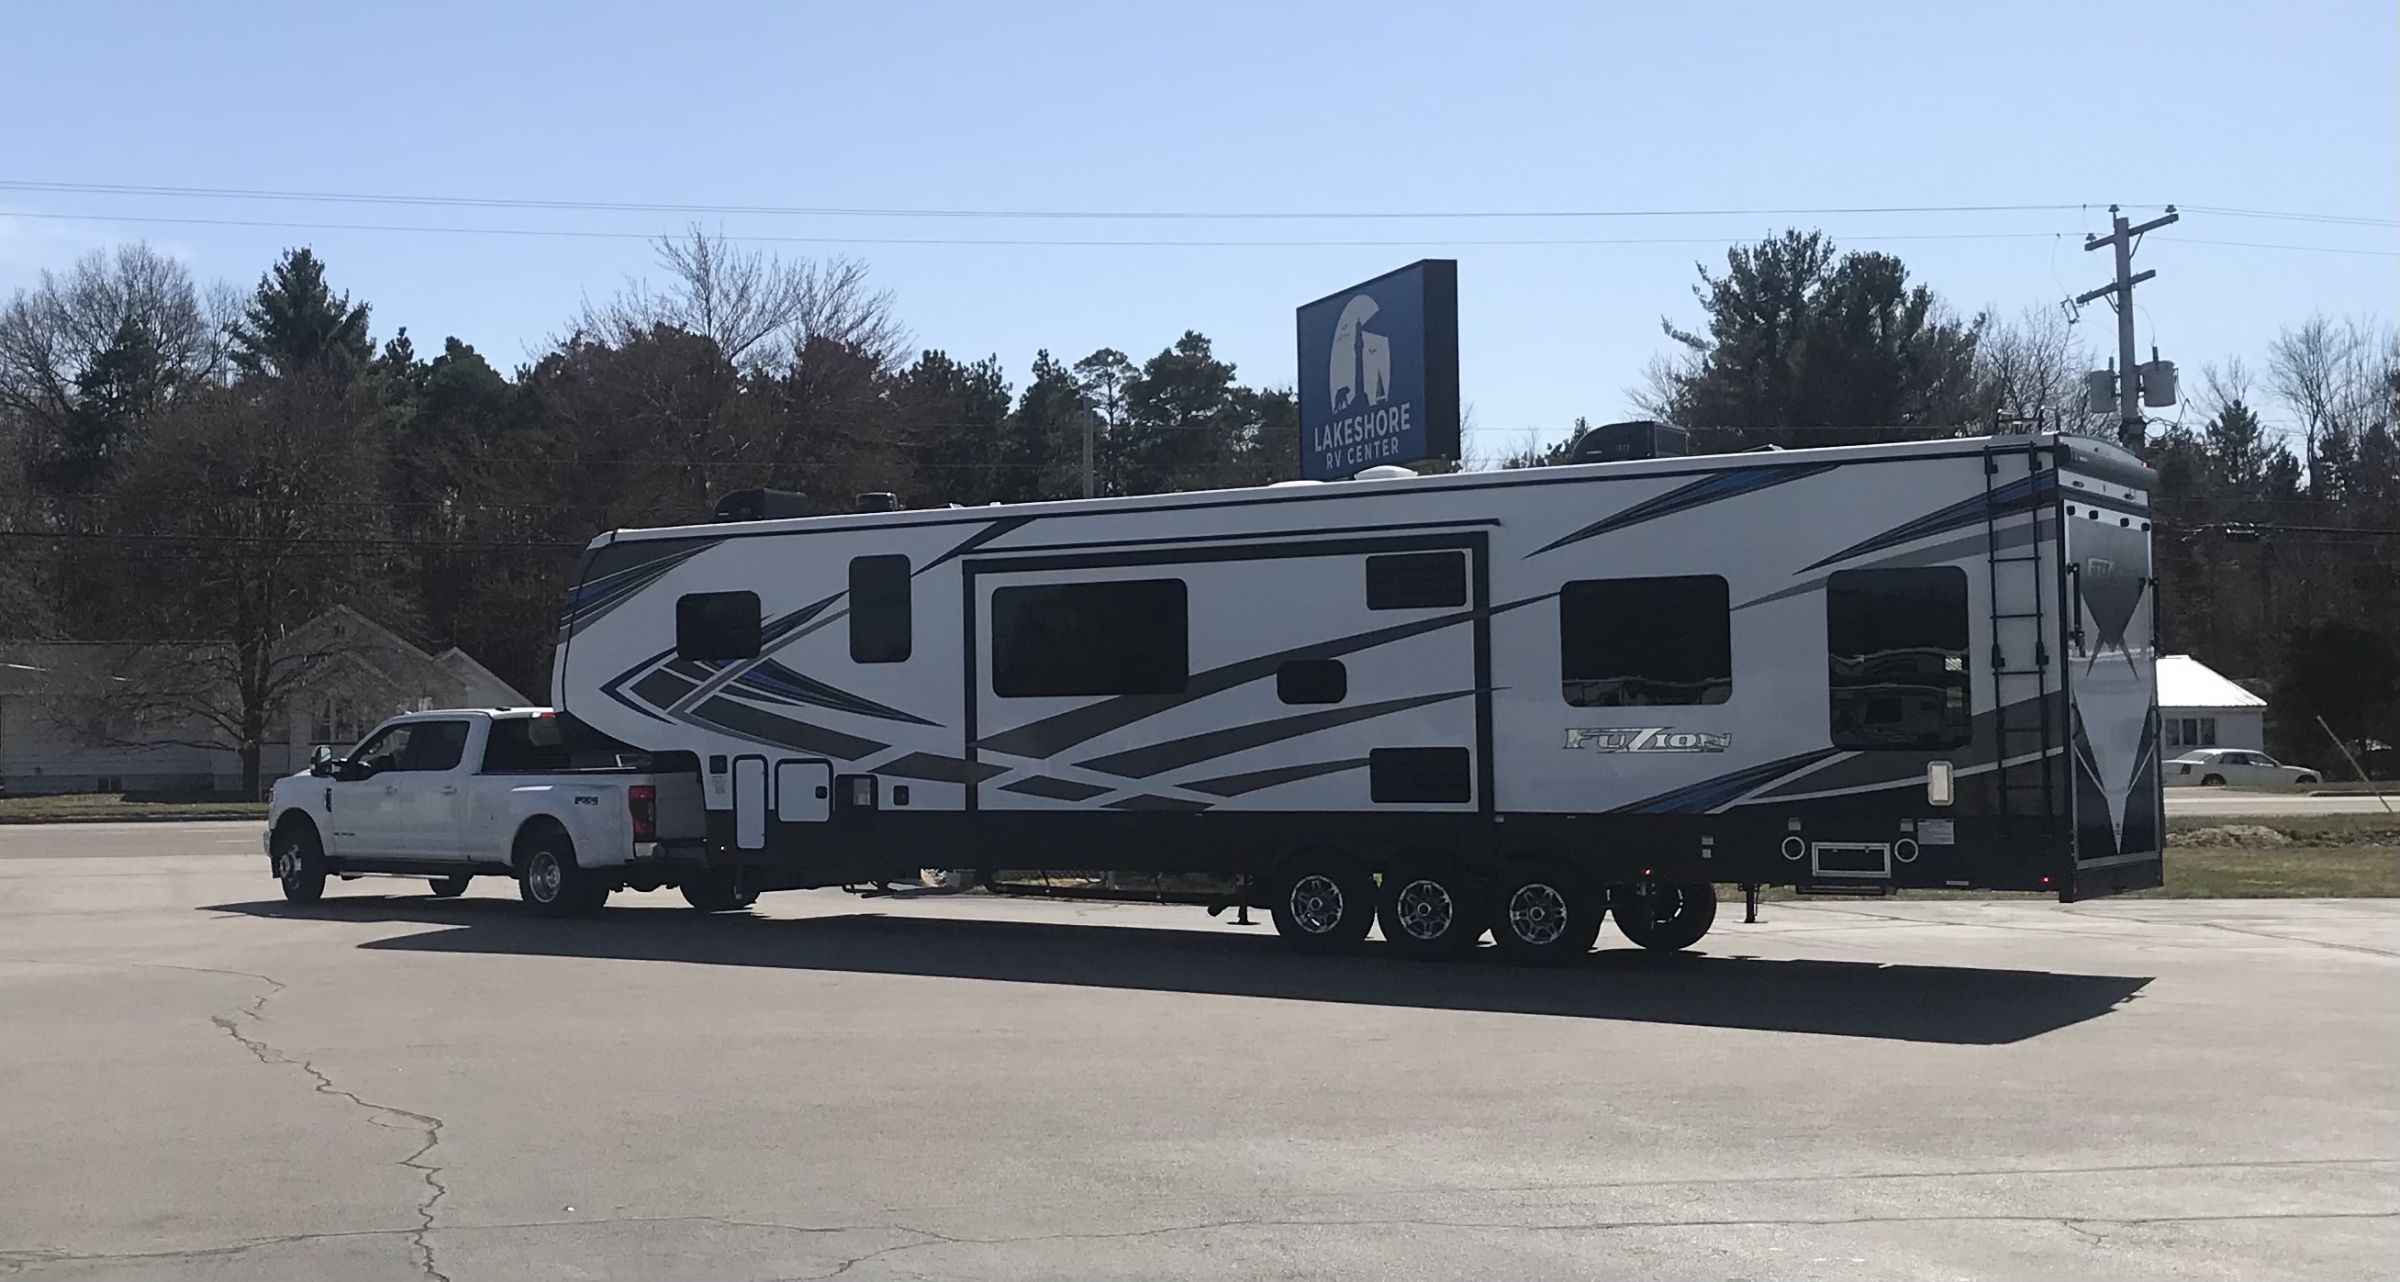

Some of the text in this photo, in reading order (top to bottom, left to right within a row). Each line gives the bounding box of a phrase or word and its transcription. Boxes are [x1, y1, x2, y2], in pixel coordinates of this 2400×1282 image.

[1314, 403, 1411, 452] LAKESHORE
[1326, 437, 1399, 469] RV CENTER
